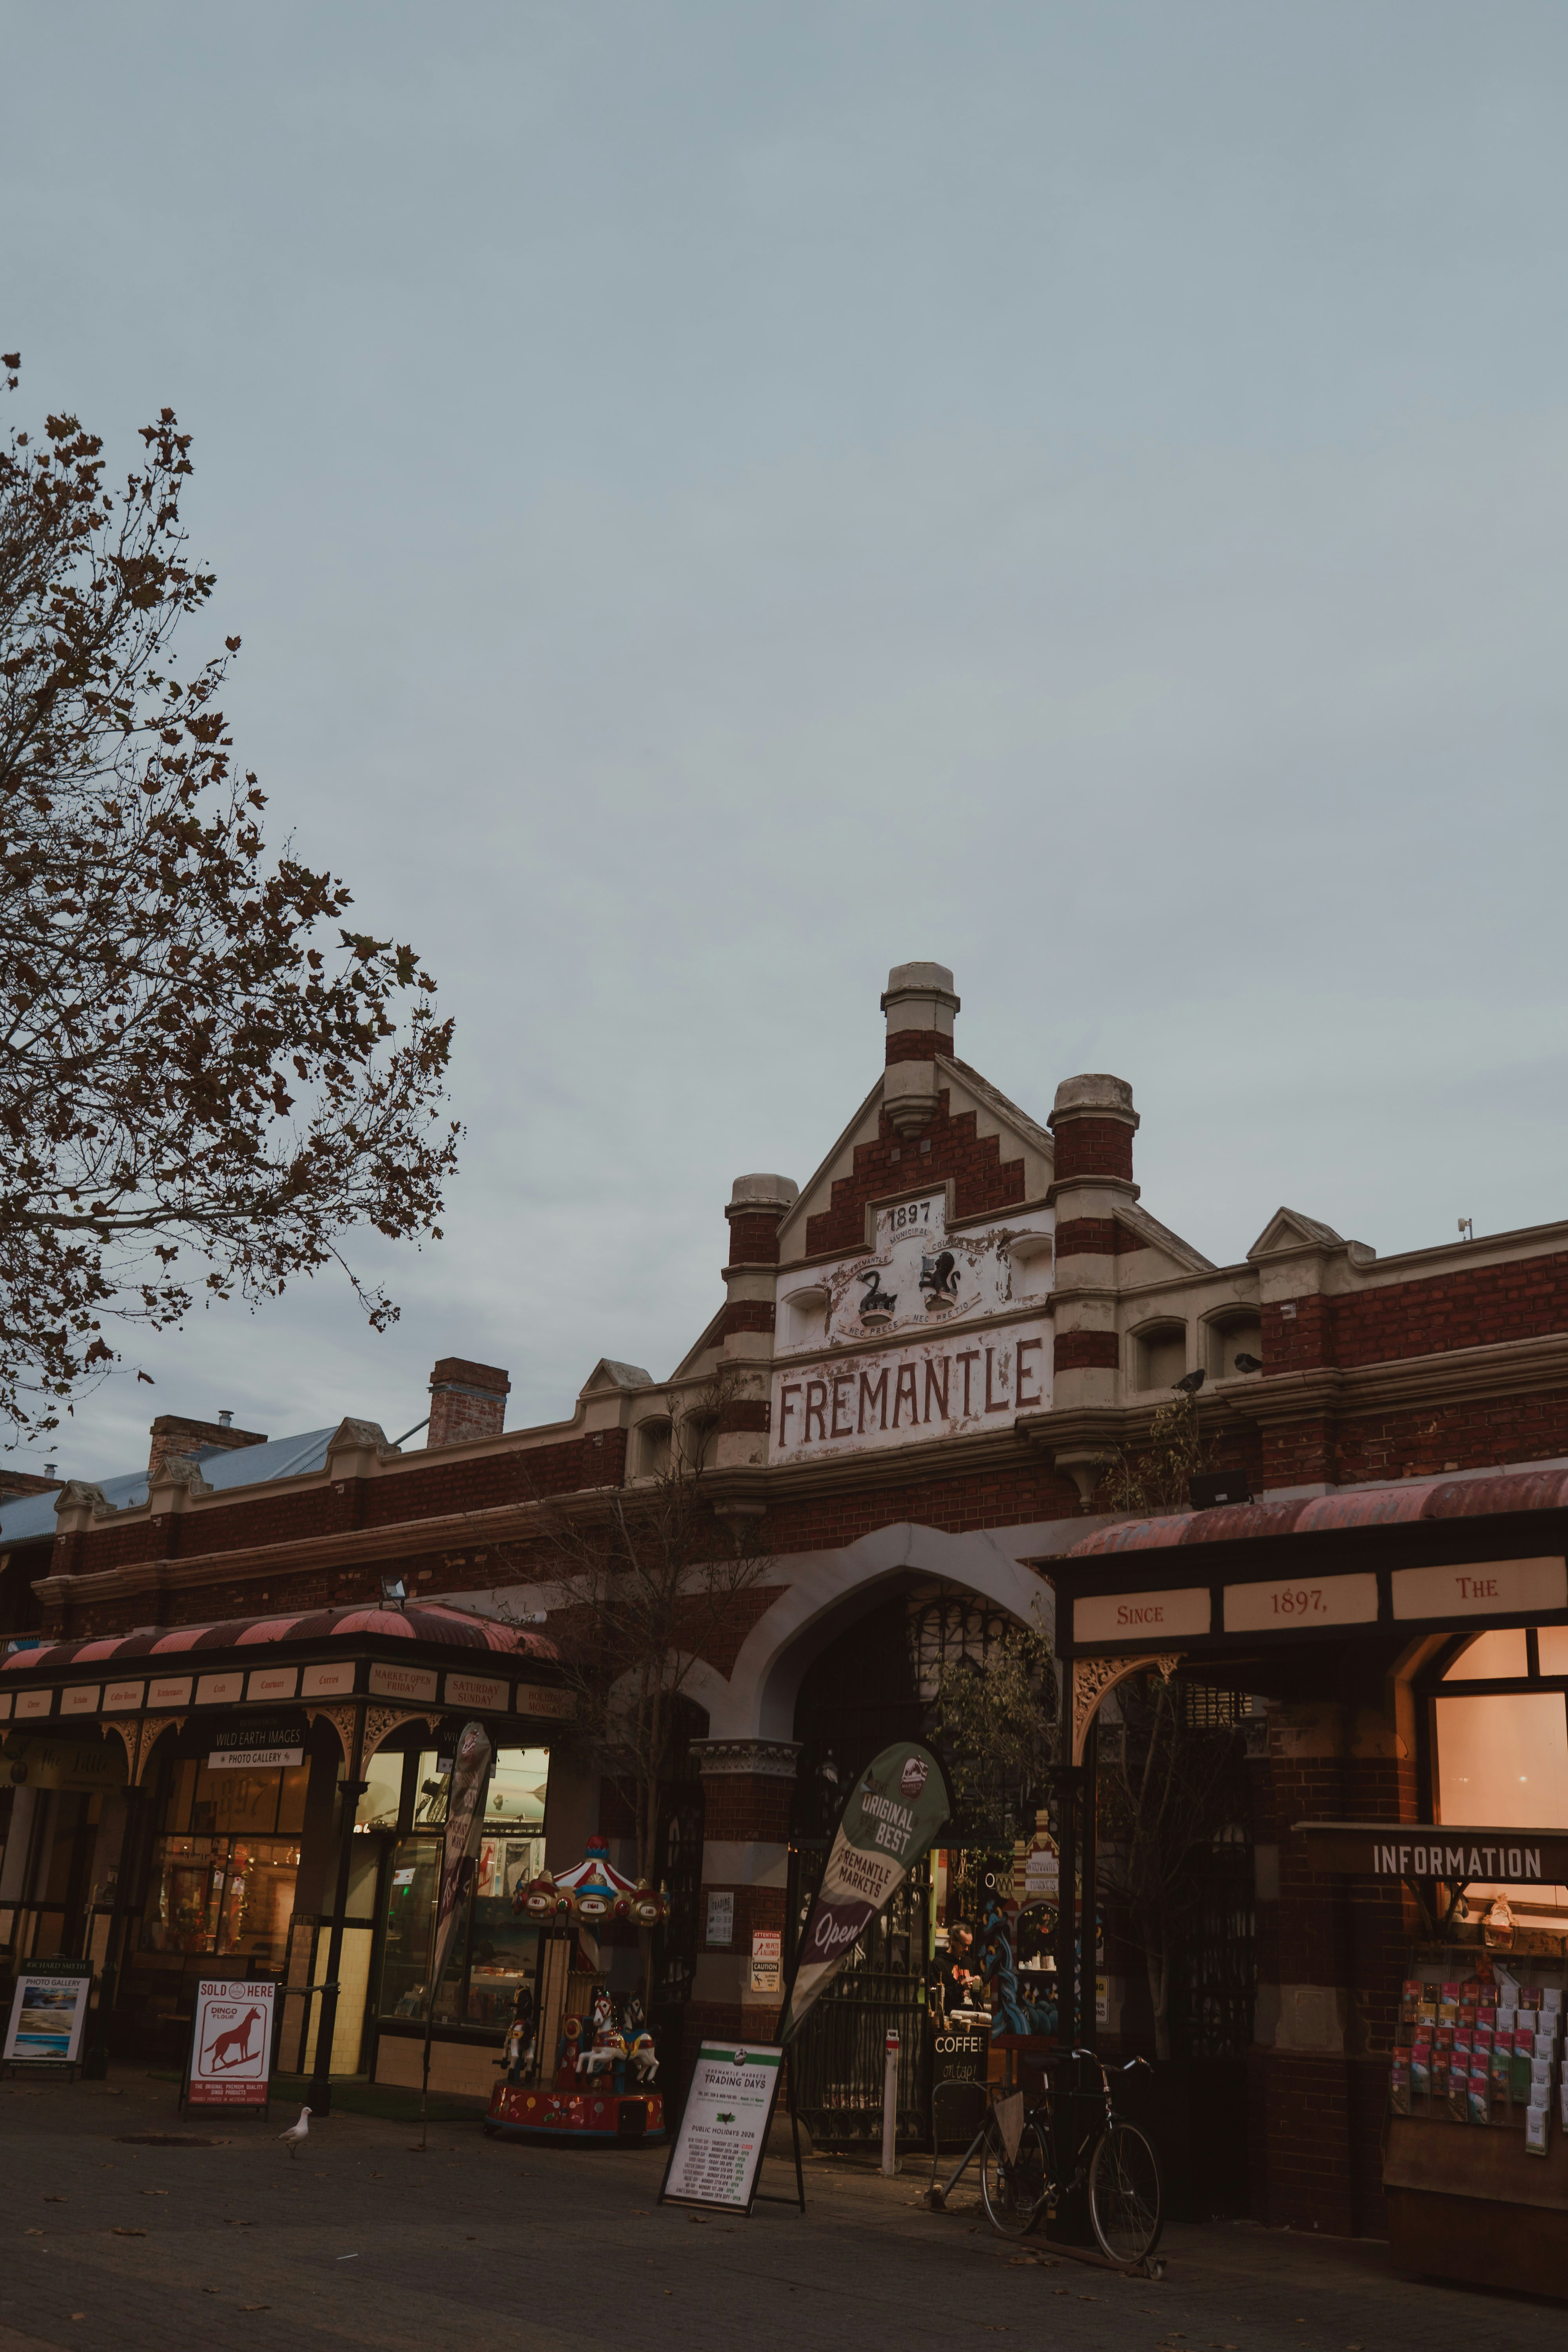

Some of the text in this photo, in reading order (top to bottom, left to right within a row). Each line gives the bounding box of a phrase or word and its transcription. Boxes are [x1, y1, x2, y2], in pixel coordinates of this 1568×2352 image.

[888, 1202, 930, 1231] 1897
[890, 1229, 928, 1245] MUNICIPAL
[850, 1256, 888, 1274] FREMANTLE
[849, 1327, 864, 1336] NEC
[870, 1321, 898, 1335] PRECE
[936, 1302, 968, 1322] PRETIO
[779, 1338, 1042, 1447] FREMANTLE
[1271, 1589, 1327, 1615] 1897,
[261, 1681, 284, 1689] Caneware
[319, 1675, 339, 1684] Curries
[375, 1670, 431, 1685] MARKET OPEN
[157, 1689, 183, 1697] Kitchenware
[214, 1684, 225, 1693] Craft
[387, 1681, 417, 1692] FRIDAY
[453, 1681, 500, 1695] SATURDAY
[111, 1693, 123, 1701] Coffee
[458, 1693, 494, 1705] SUNDAY
[529, 1691, 564, 1703] HOLIDAY
[529, 1702, 564, 1714] MONDAY
[216, 1729, 300, 1746] WILD EARTH IMAGES
[444, 1731, 458, 1742] WIL
[71, 1752, 108, 1773] Little
[229, 1753, 281, 1763] PHOTO GALLERY
[208, 1777, 269, 1818] 1897
[862, 1793, 913, 1832] ORIGINAL
[875, 1822, 910, 1855] BEST
[837, 1848, 891, 1884] FREMANTLE
[1374, 1845, 1541, 1878] INFORMATION
[839, 1866, 882, 1898] MARKETS
[1031, 1880, 1055, 1890] MARKETS
[712, 1897, 730, 1911] TRADING
[201, 1984, 273, 1997] SOLD HERE
[935, 2037, 984, 2053] COFFEE
[943, 2064, 955, 2078] on
[706, 2074, 766, 2089] TRADING DAYS
